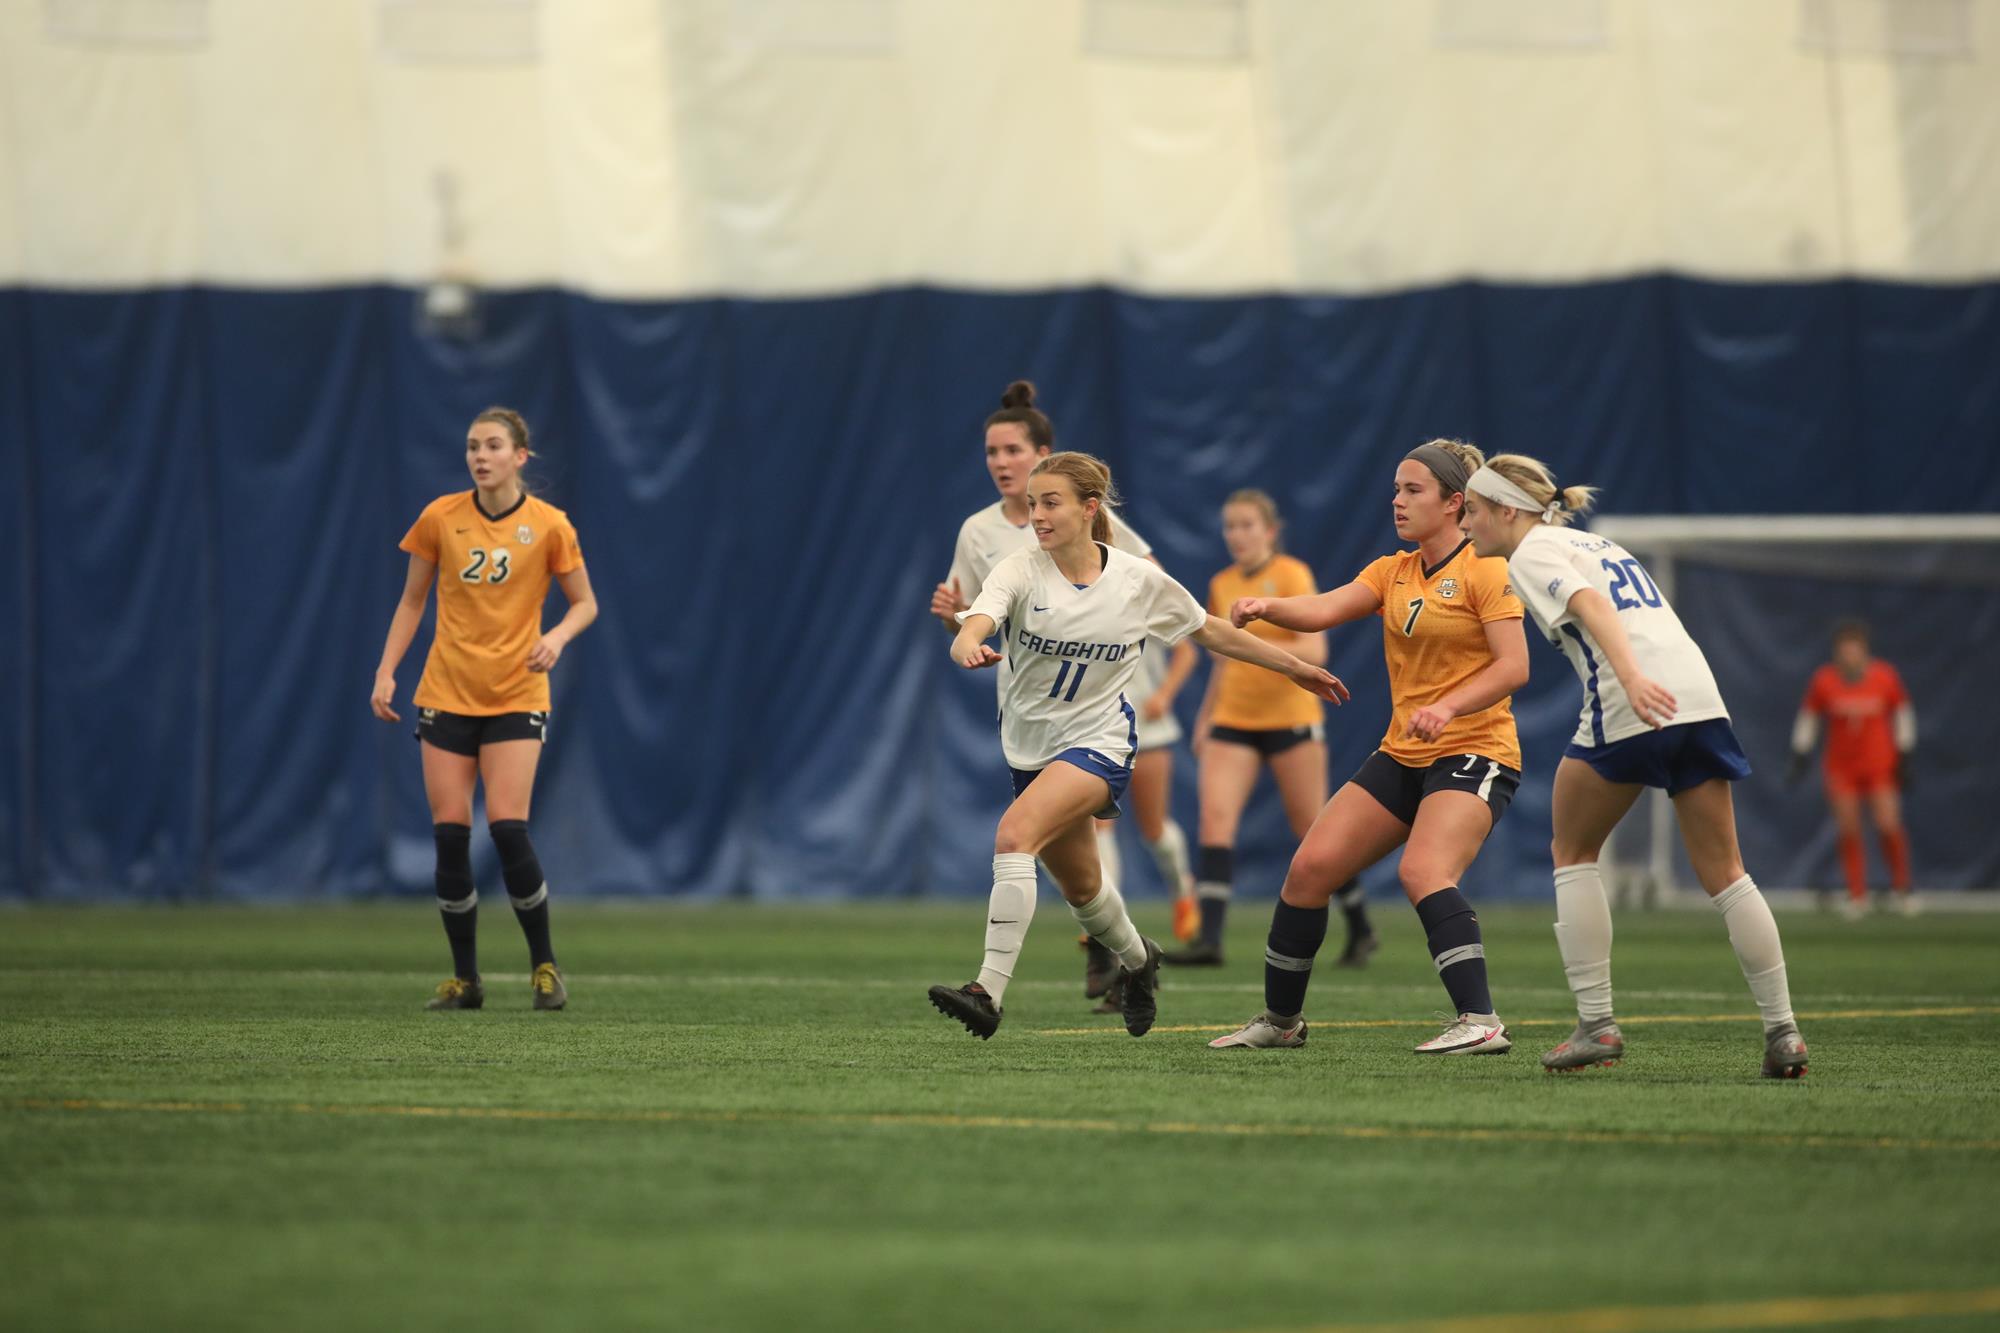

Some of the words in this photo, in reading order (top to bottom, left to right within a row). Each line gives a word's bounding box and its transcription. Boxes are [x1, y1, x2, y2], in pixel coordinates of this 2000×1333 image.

[460, 549, 511, 583] 23
[1600, 557, 1663, 612] 20
[1048, 660, 1089, 703] 11
[1463, 754, 1478, 771] 7
